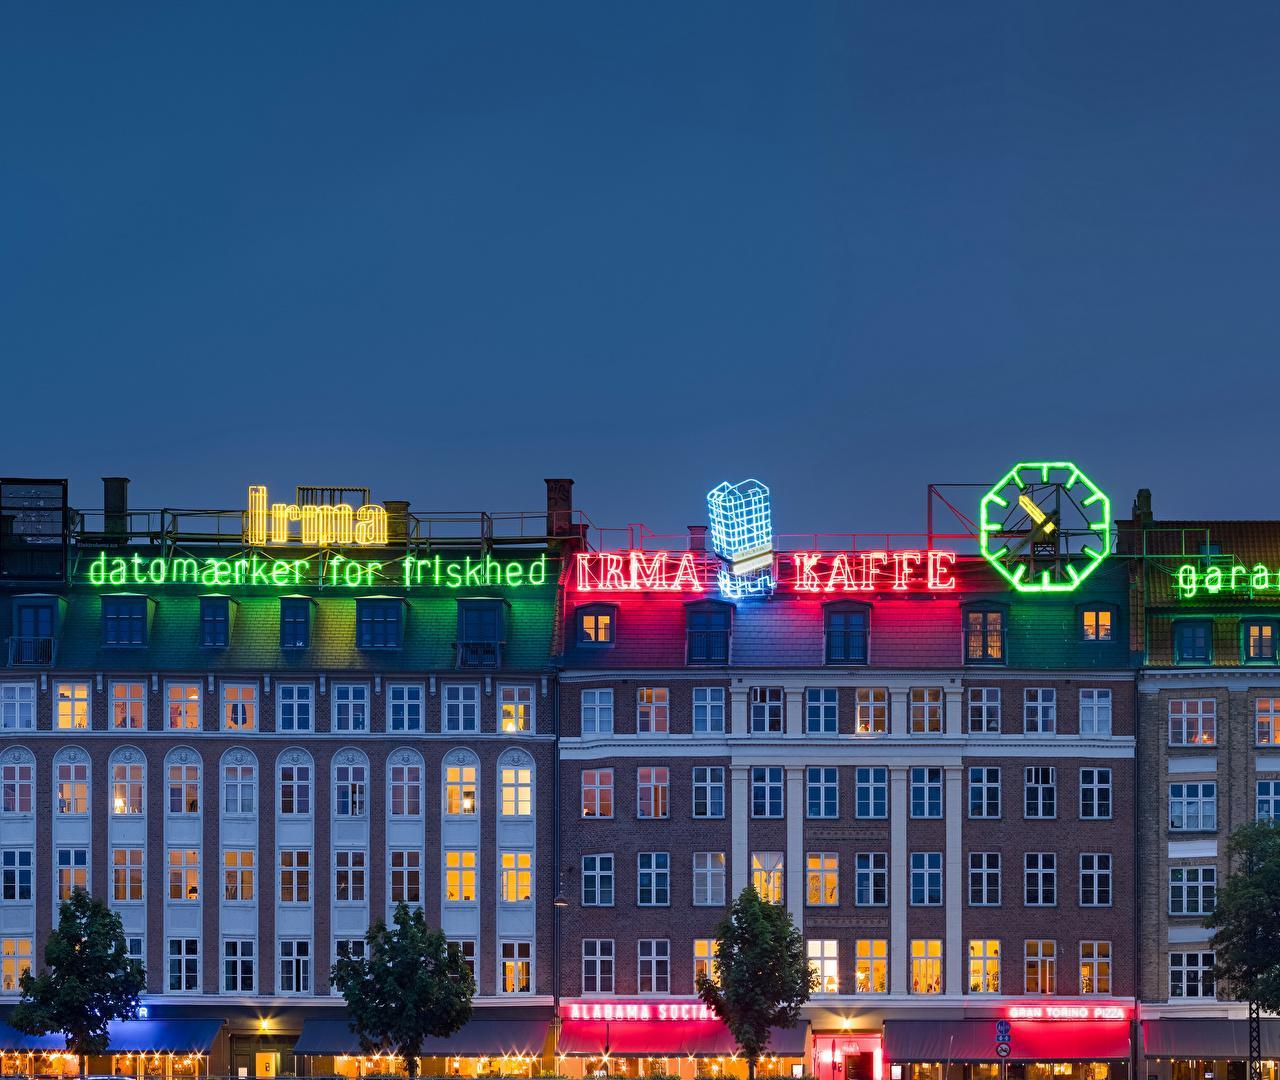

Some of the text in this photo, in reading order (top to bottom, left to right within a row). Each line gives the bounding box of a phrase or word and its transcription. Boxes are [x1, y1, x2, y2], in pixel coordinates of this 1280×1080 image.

[247, 485, 389, 547] Irma
[89, 551, 547, 589] datomærker for friskhed
[575, 551, 958, 592] IRMA KAFFE
[571, 1004, 650, 1021] ALABAMA
[1009, 1007, 1125, 1019] GRAN TORINO PIZZA
